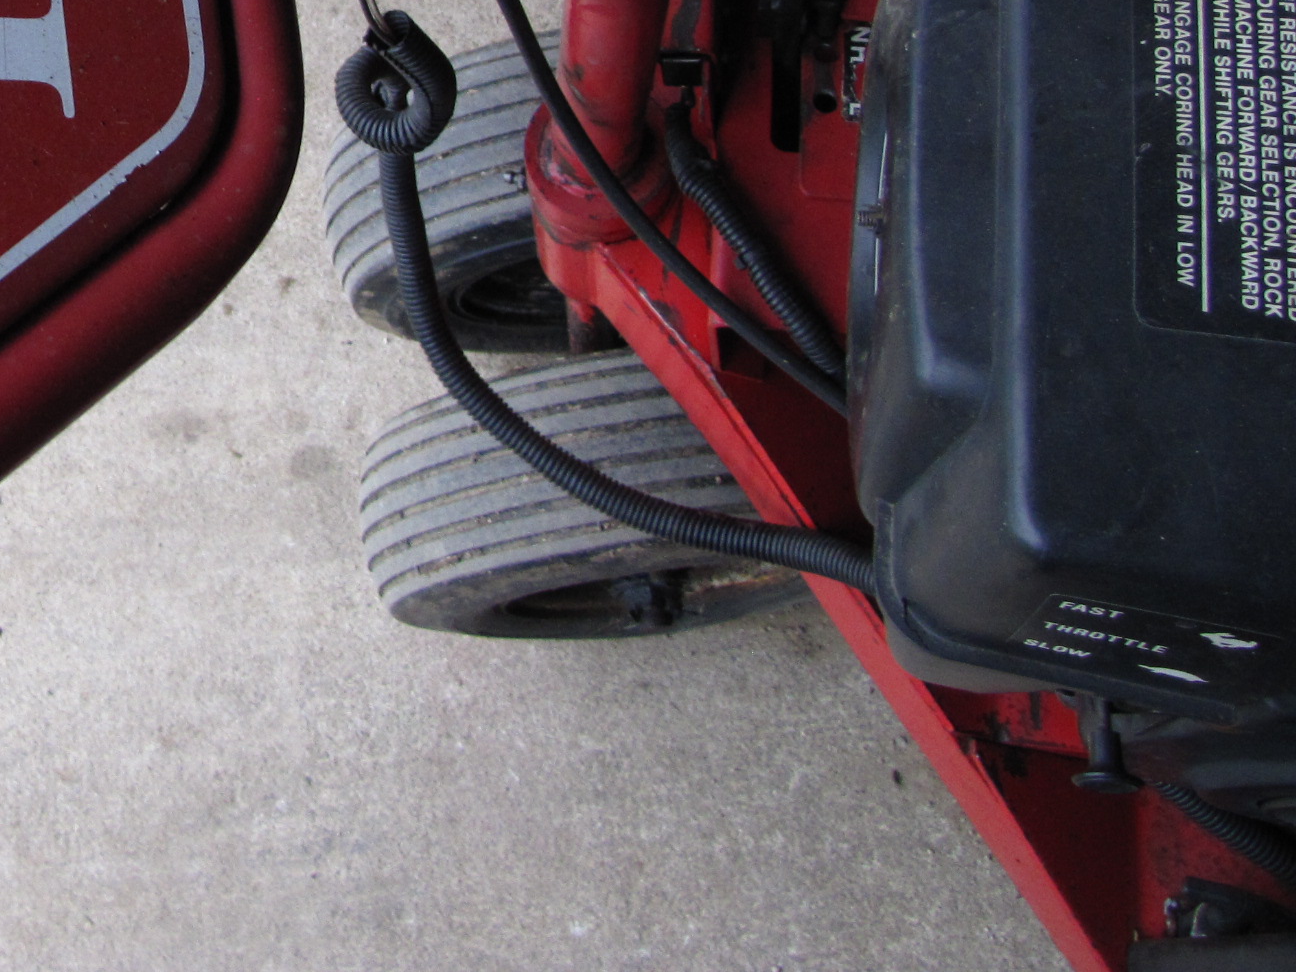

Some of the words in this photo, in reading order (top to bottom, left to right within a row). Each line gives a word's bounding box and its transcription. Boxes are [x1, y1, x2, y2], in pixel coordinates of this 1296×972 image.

[1155, 46, 1172, 98] ONLY.
[1279, 17, 1296, 136] RESISTANCE
[1175, 73, 1193, 147] CORING
[1214, 55, 1234, 145] SHIFTING
[1259, 75, 1278, 128] GEAR
[1283, 142, 1296, 160] IS
[1176, 154, 1194, 208] HEAD
[1216, 151, 1235, 223] GEARS.
[1260, 133, 1282, 251] SELECTION,
[1177, 214, 1194, 234] IN
[1177, 241, 1195, 287] LOW
[1263, 258, 1283, 318] ROCK
[1058, 600, 1125, 619] FAST
[1022, 638, 1093, 658] SLOW
[1043, 621, 1170, 654] THROTTLE
